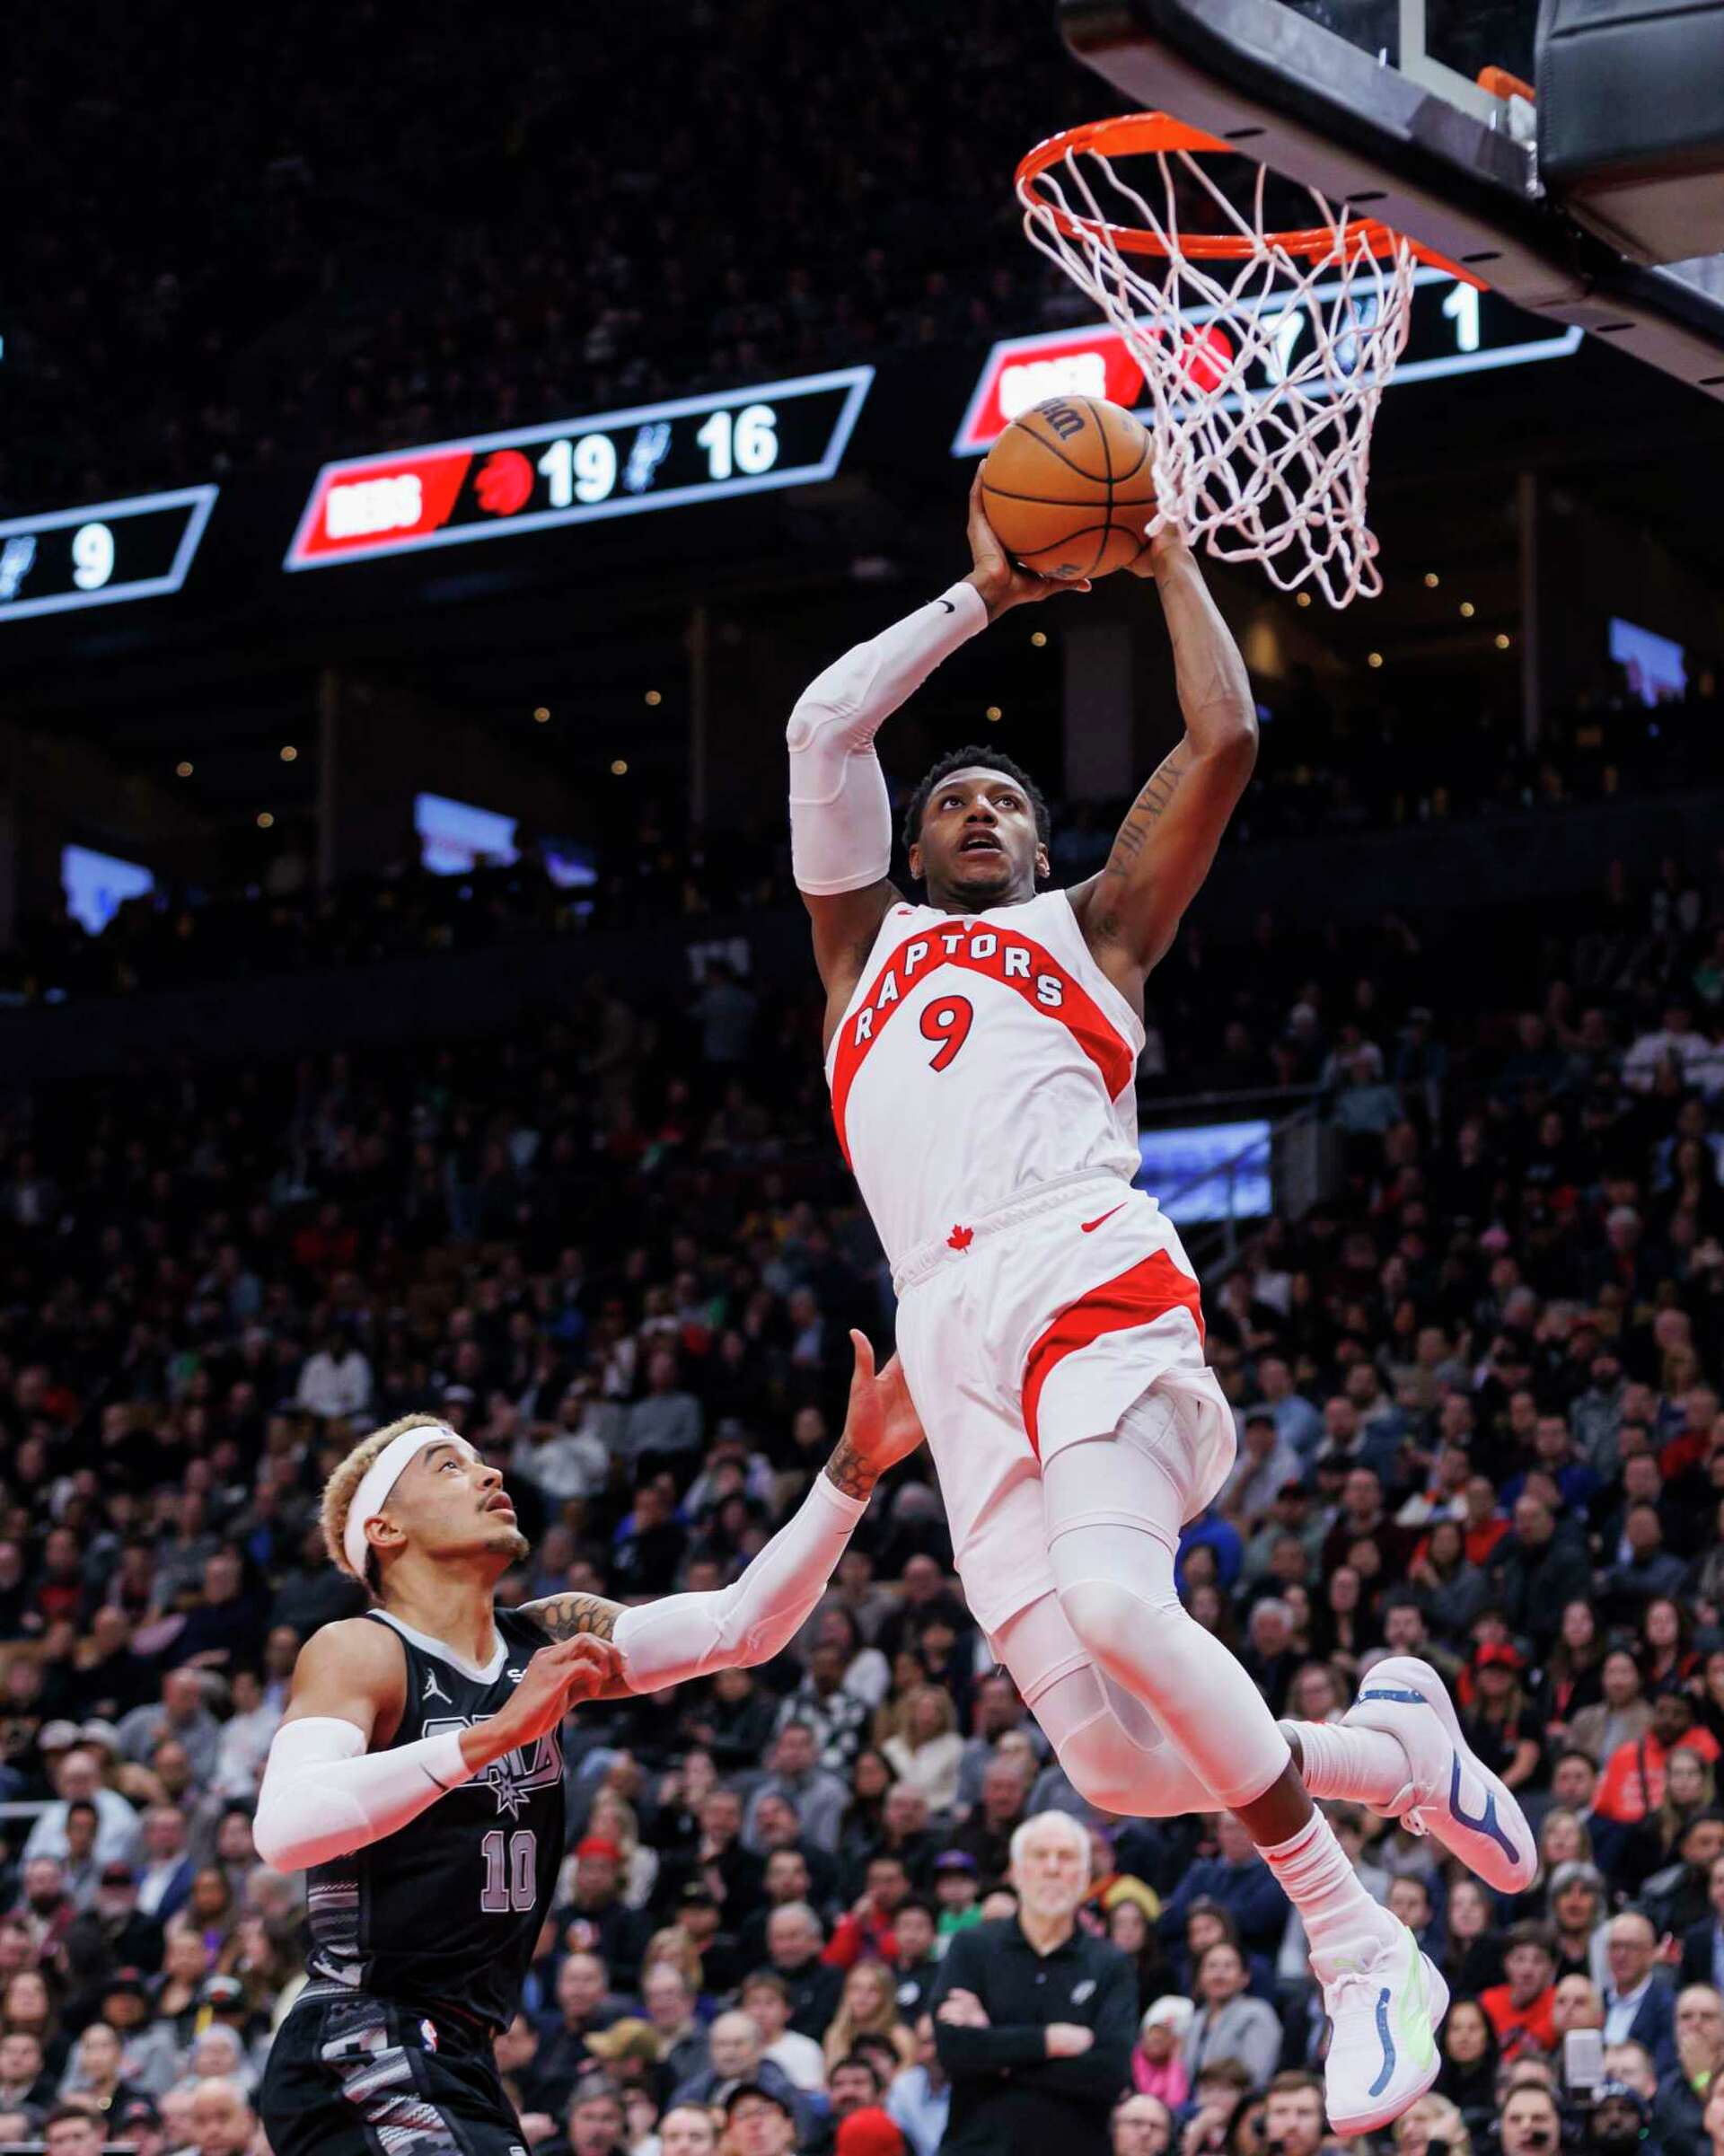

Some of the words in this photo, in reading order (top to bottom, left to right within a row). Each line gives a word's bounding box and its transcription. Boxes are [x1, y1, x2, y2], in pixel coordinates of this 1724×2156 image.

[1261, 310, 1305, 383] 7
[1442, 281, 1480, 352] 1
[538, 434, 617, 508] 19
[697, 404, 778, 480] 16
[72, 522, 115, 590] 9
[854, 933, 1064, 1047] RAPTORS
[919, 994, 973, 1073] 9
[480, 1829, 537, 1913] 10
